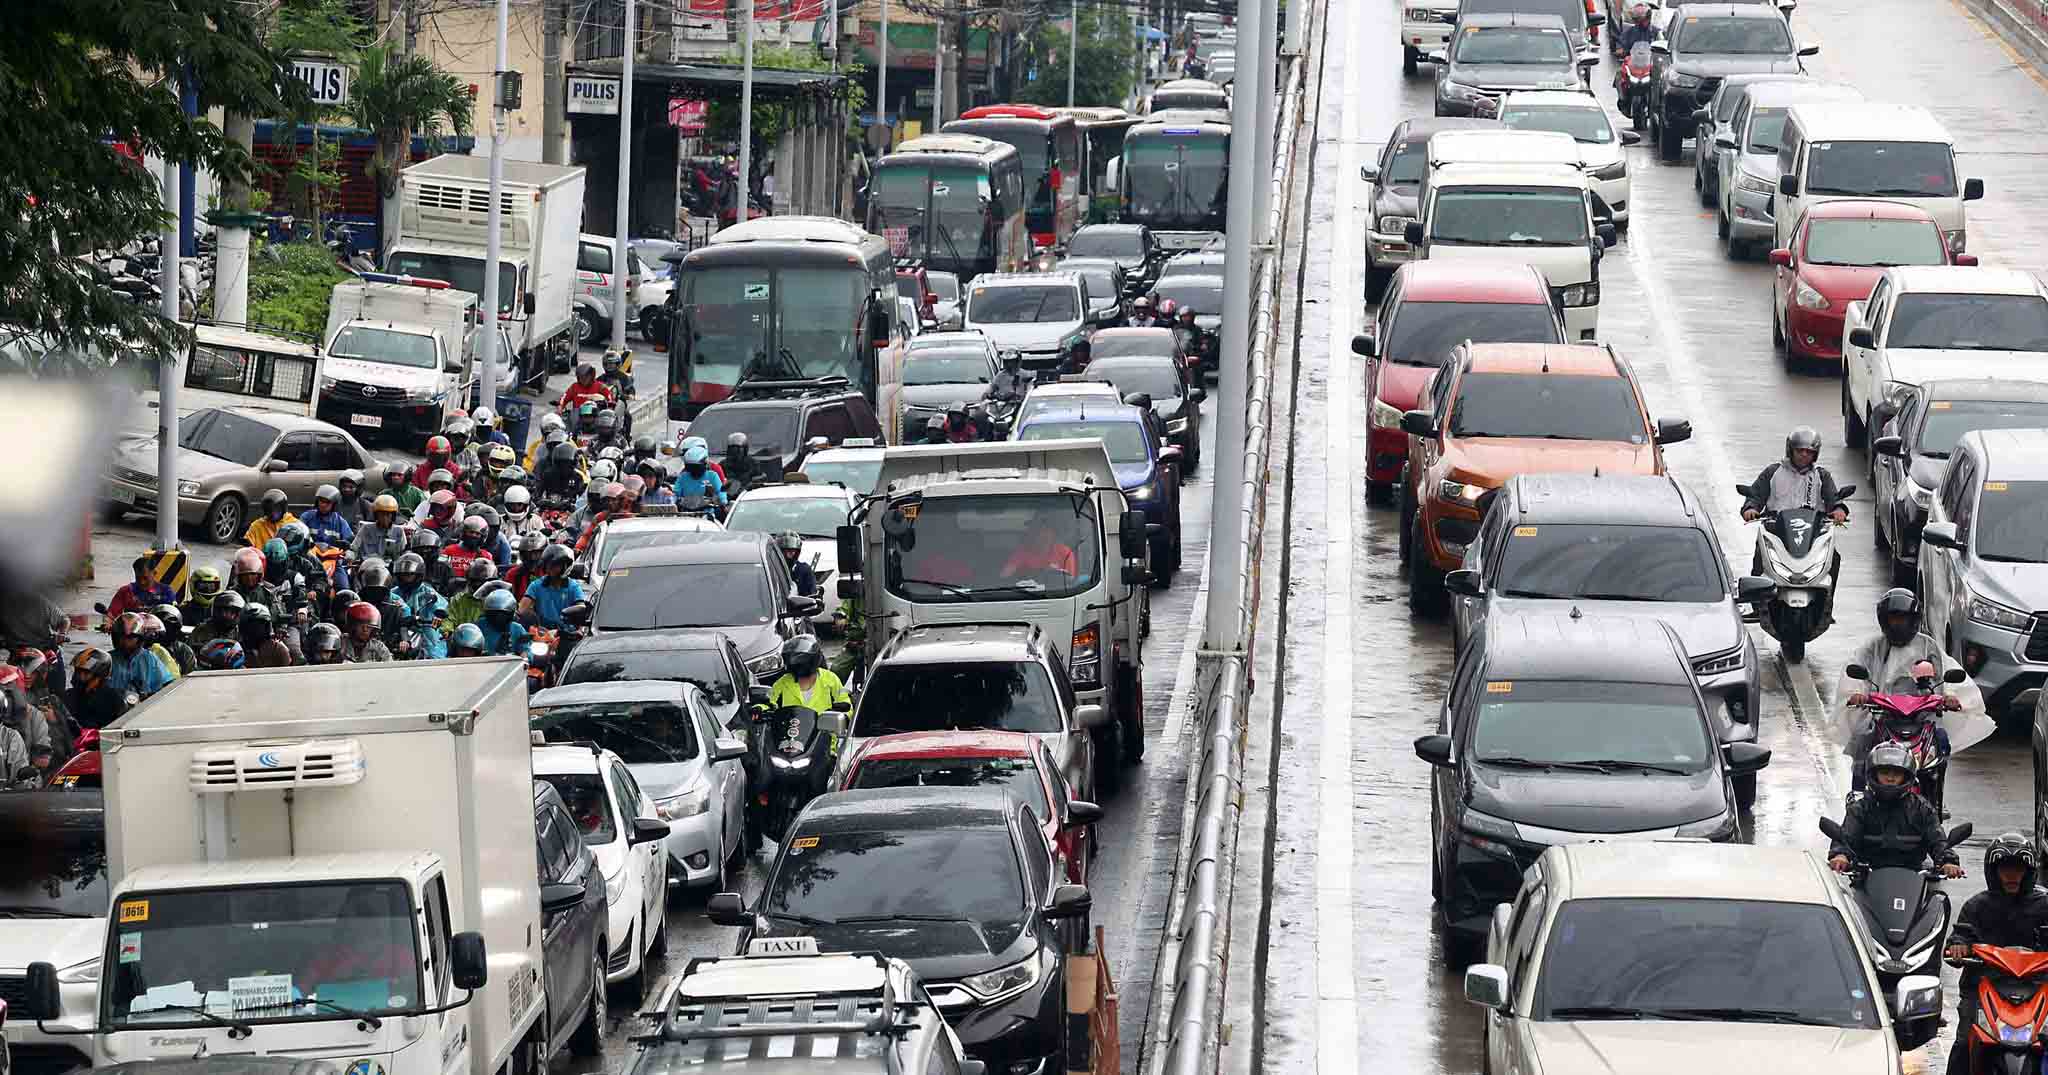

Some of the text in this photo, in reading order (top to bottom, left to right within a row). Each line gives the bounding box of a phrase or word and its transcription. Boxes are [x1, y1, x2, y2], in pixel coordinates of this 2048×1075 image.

[573, 82, 615, 100] PULIS
[761, 941, 801, 953] TAXI
[232, 985, 288, 996] PERISHABLE GOODS
